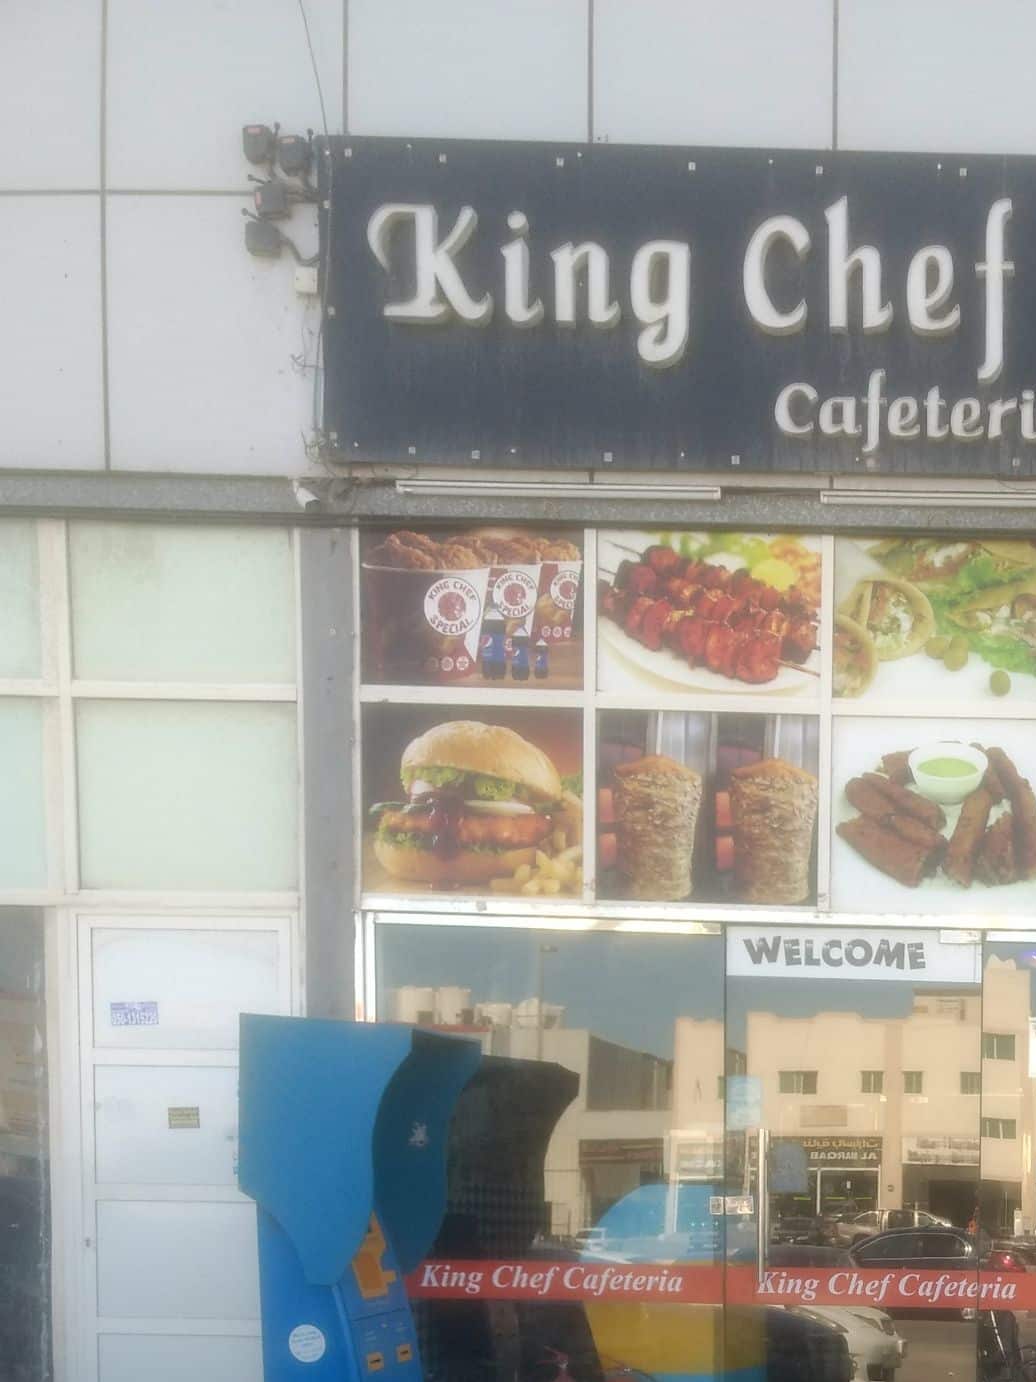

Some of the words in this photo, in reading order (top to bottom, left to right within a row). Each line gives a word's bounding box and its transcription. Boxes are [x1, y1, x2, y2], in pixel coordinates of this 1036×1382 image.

[366, 202, 692, 368] King
[742, 195, 1015, 383] Chef
[428, 580, 450, 600] KING
[453, 580, 478, 601] CHEF
[430, 614, 475, 635] SPECIAL
[743, 935, 927, 970] WELCOME
[420, 1264, 483, 1294] King
[491, 1264, 558, 1294] Chef
[563, 1265, 684, 1296] Cafeteria
[757, 1271, 820, 1300] King
[828, 1271, 894, 1302] Chef
[898, 1271, 1017, 1303] Cafeteria
